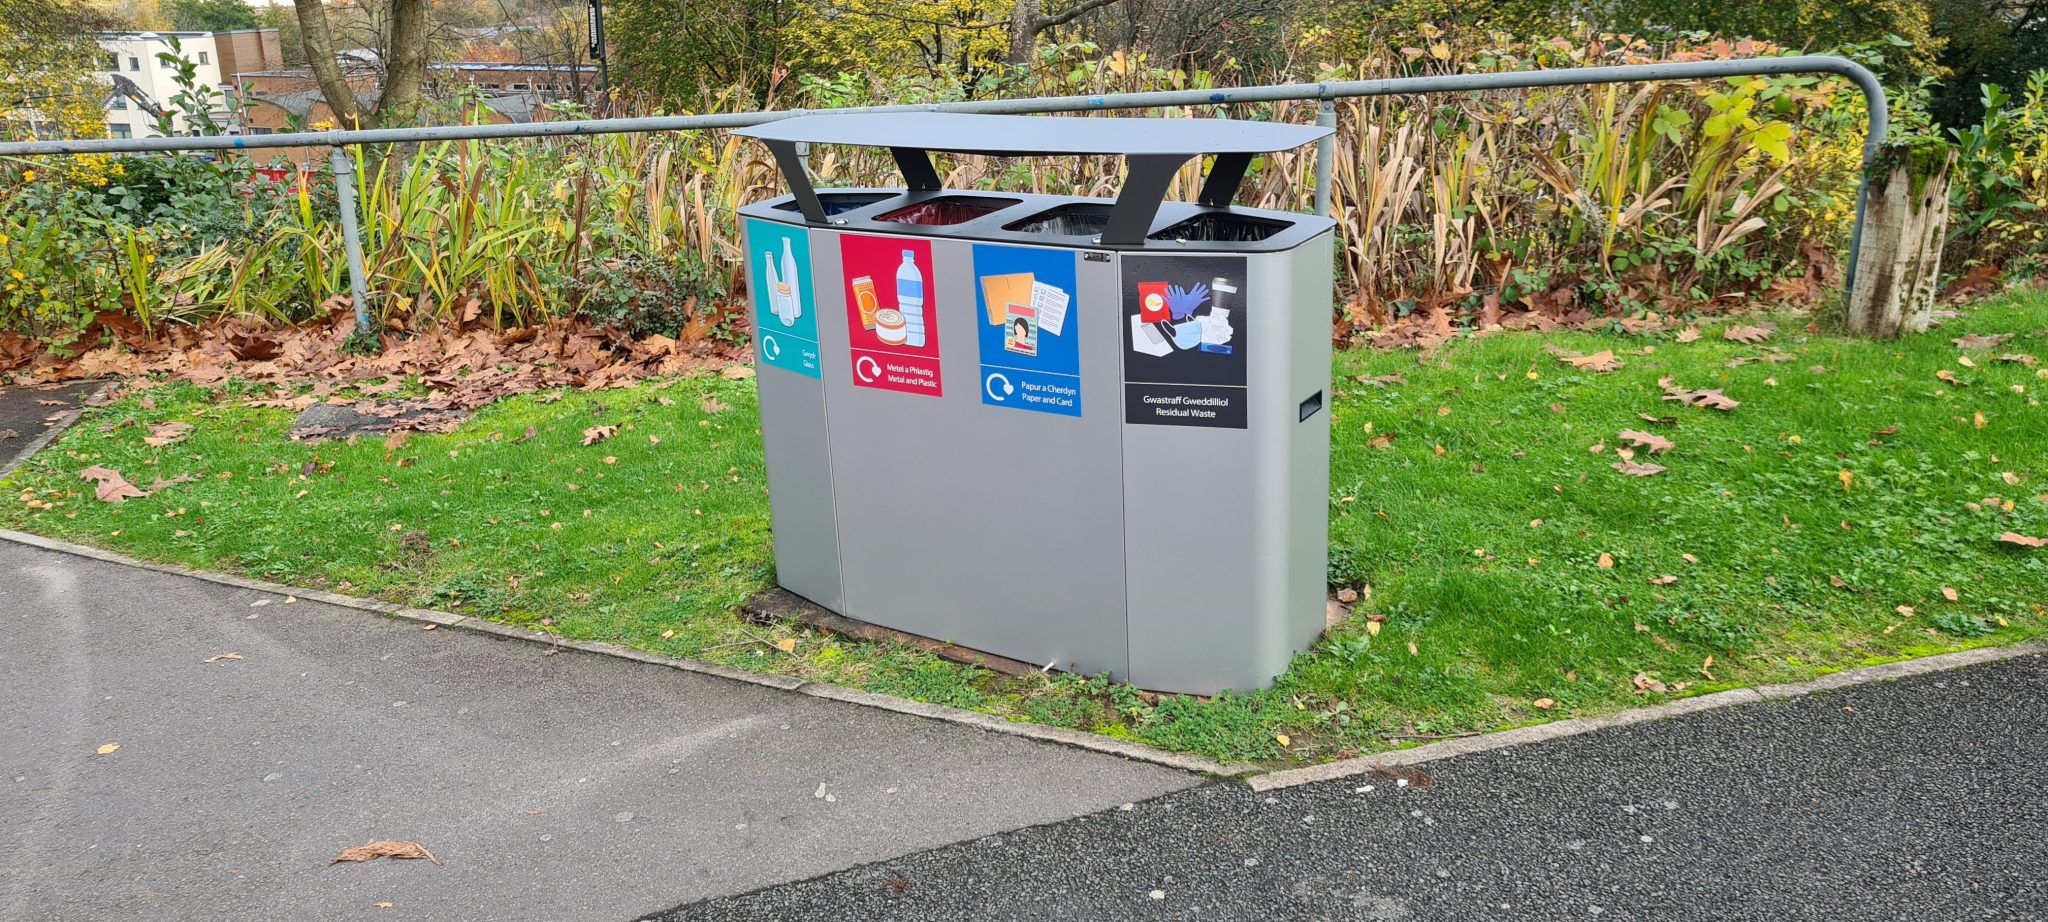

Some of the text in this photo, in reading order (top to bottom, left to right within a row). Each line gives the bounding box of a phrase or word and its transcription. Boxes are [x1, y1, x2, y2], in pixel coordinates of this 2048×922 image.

[802, 359, 815, 369] Glass
[886, 364, 905, 373] Metel
[909, 367, 934, 378] Phlastig
[887, 374, 938, 388] Metal and Plastic
[1021, 381, 1041, 392] Papur
[1047, 384, 1076, 397] Cherdyn
[1022, 392, 1073, 407] Paper and Card
[1143, 395, 1229, 407] Gwastraff Gweddilliol
[1156, 407, 1216, 418] Residual Waste
